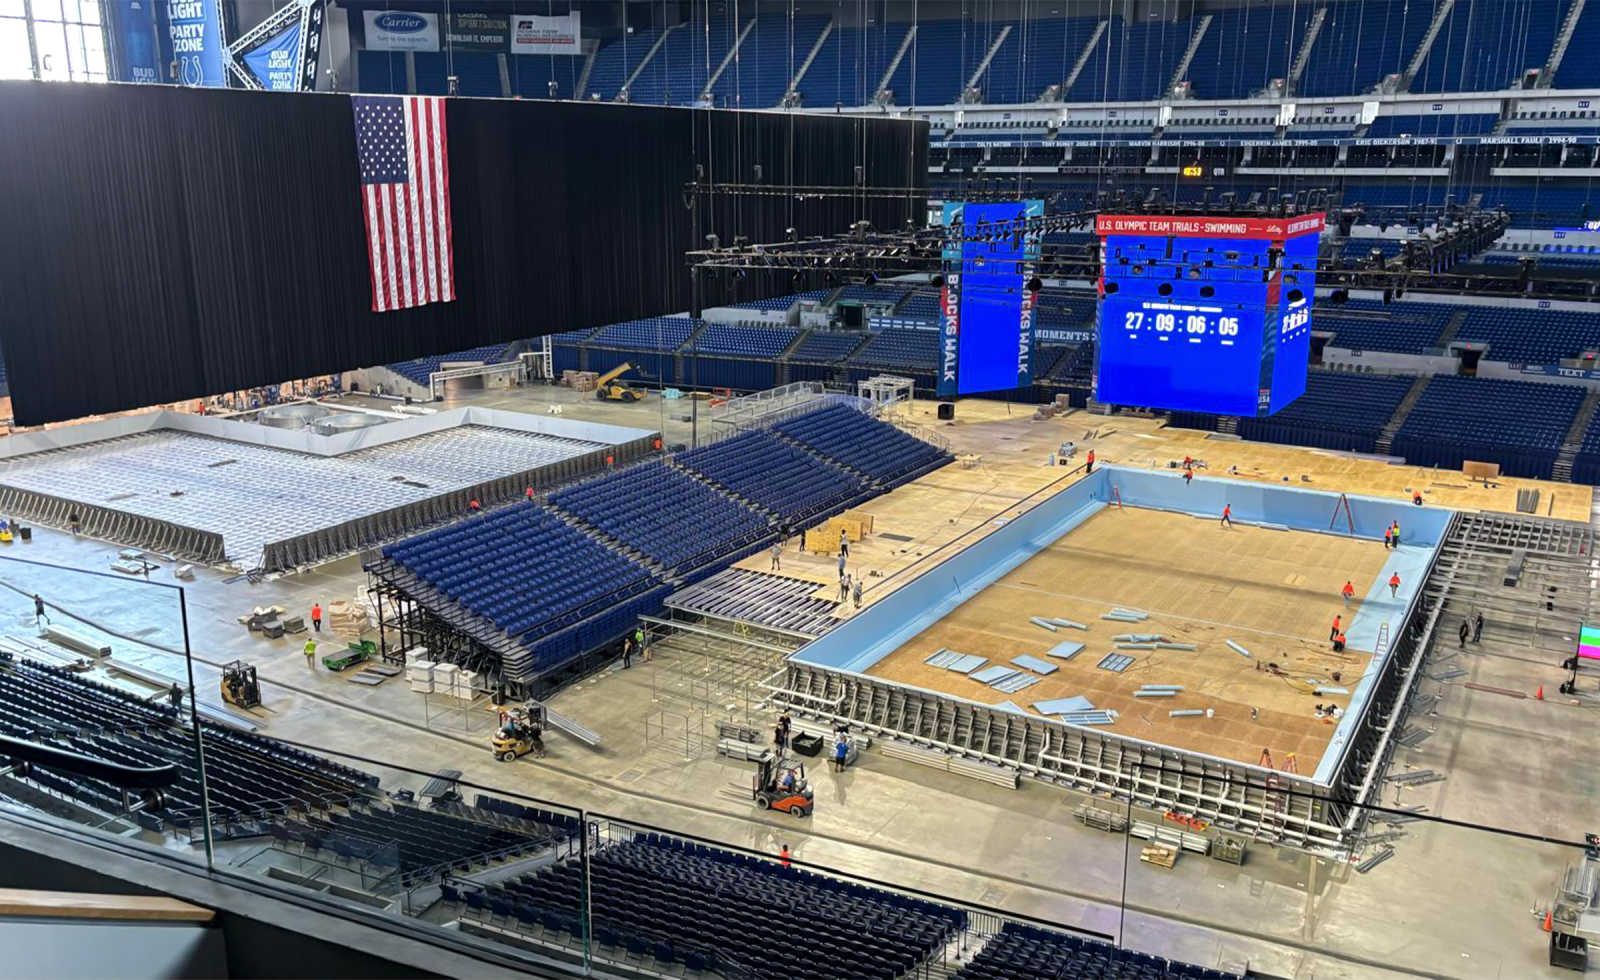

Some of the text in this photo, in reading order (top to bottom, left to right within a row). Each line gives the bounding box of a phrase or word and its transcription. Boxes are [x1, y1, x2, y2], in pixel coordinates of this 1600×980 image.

[170, 3, 203, 19] LIGHT
[382, 16, 422, 28] Carrier
[169, 24, 205, 38] PARTY
[174, 38, 204, 52] ZONE
[133, 67, 154, 78] BUD
[1099, 219, 1113, 231] U.S.
[1115, 220, 1147, 231] OLYMPIC
[1149, 221, 1170, 232] TEAM
[1034, 329, 1090, 341] MOMENTS
[1016, 332, 1030, 374] WALK
[943, 338, 957, 382] WALK
[1558, 368, 1585, 377] TEXT
